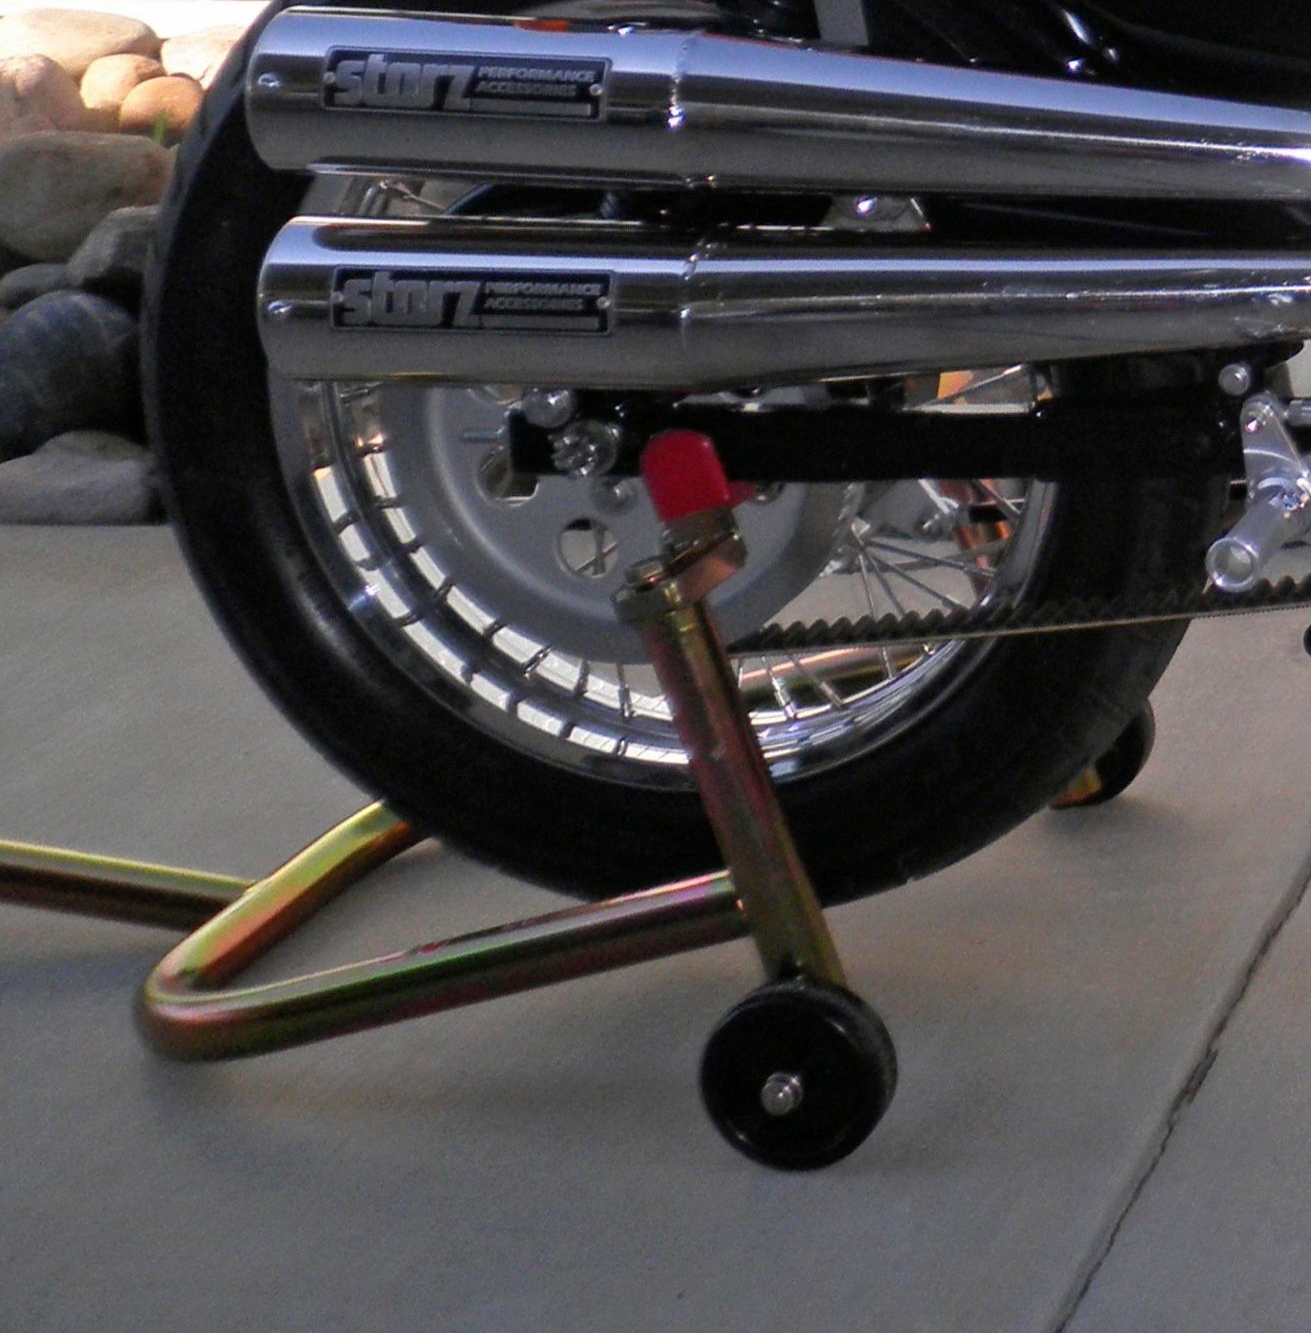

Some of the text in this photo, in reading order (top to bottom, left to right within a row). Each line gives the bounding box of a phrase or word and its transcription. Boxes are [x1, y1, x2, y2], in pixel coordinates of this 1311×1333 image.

[334, 54, 477, 111] storz
[479, 66, 595, 83] PERFORMANCE
[343, 271, 482, 328] storz
